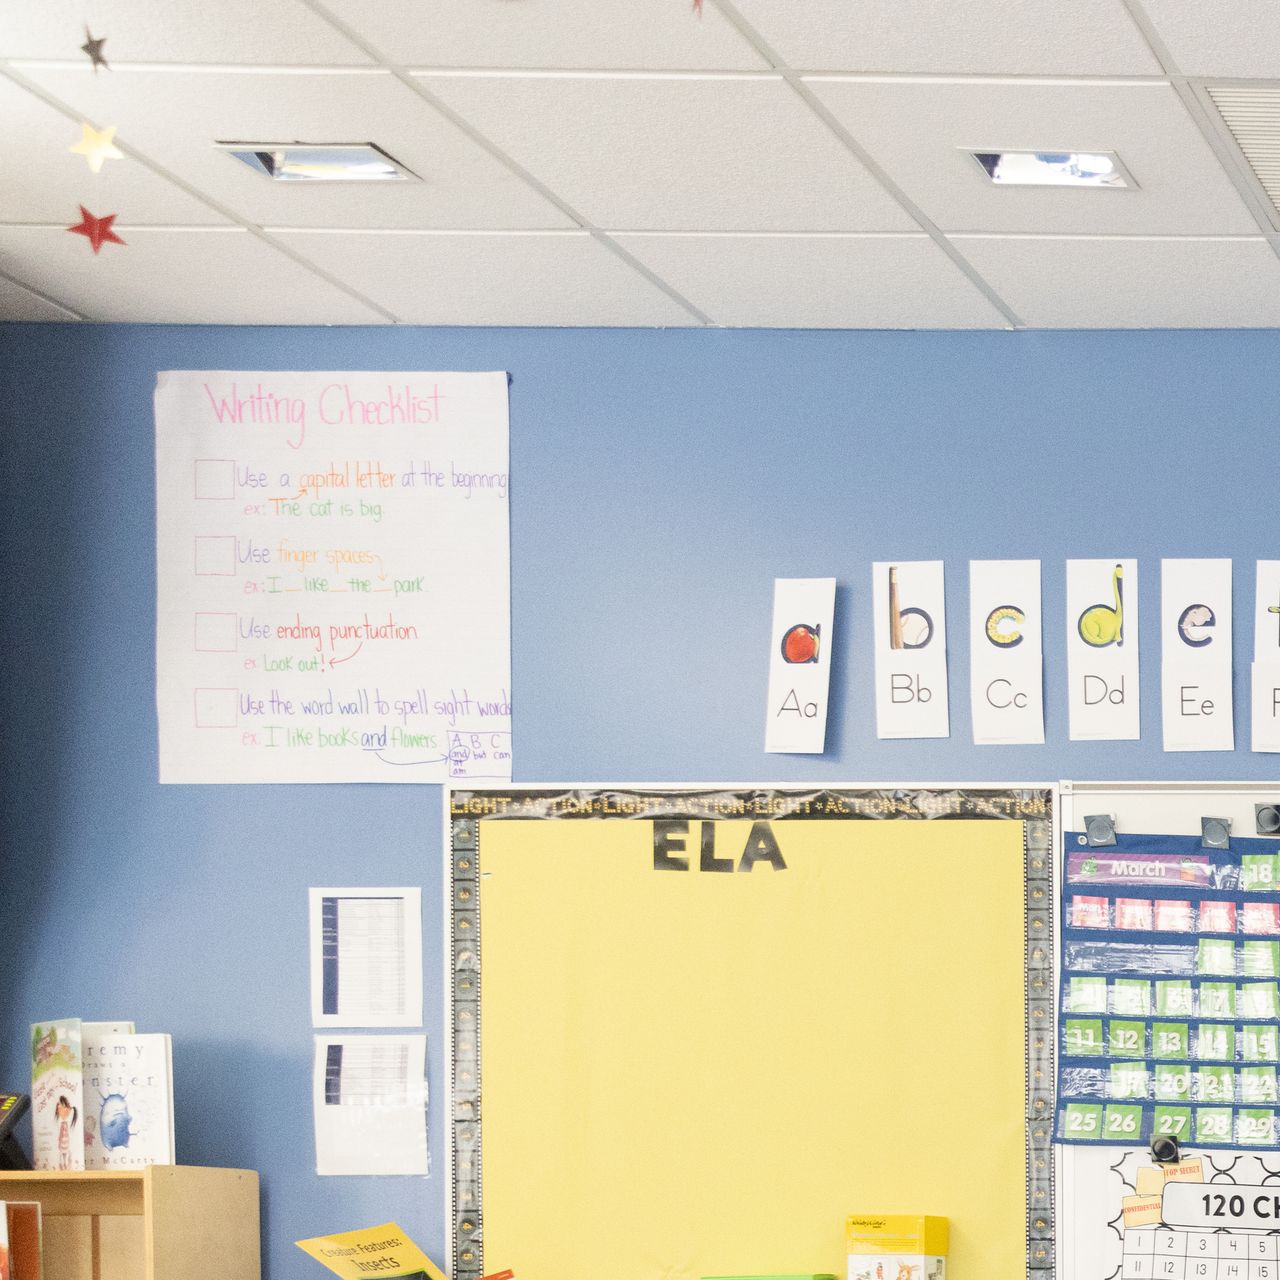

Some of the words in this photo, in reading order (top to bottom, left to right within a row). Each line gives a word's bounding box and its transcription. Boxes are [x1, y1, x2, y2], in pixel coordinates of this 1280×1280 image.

[203, 382, 306, 451] Writing
[318, 383, 446, 425] Checklist
[238, 466, 268, 488] Use
[280, 473, 290, 488] a
[300, 462, 350, 499] capital
[355, 462, 395, 488] letter
[402, 463, 417, 487] at
[421, 463, 445, 488] the
[452, 462, 506, 499] beginning
[244, 503, 266, 515] ex:
[269, 498, 302, 517] The
[309, 500, 332, 517] cat
[340, 504, 353, 517] is
[238, 540, 271, 564] Use
[278, 539, 317, 573] finger
[326, 548, 374, 573] spaces
[244, 579, 266, 594] ex:
[267, 577, 282, 593] I
[304, 577, 329, 593] like
[346, 577, 372, 593] the
[888, 566, 934, 650] b
[1076, 564, 1125, 649] d
[240, 619, 273, 640] Use
[277, 613, 322, 652] ending
[330, 613, 418, 651] punctuation
[985, 605, 1026, 648] c
[1178, 603, 1216, 648] e
[780, 623, 821, 664] a
[264, 655, 292, 671] Look
[298, 654, 326, 673] out!
[777, 689, 817, 718] Aa
[891, 674, 932, 703] Bb
[986, 678, 1027, 709] Cc
[1084, 675, 1124, 705] Dd
[1181, 686, 1214, 716] Ee
[240, 691, 266, 716] Use
[269, 689, 295, 716] the
[301, 688, 333, 715] word
[338, 688, 369, 715] wall
[375, 688, 390, 715] to
[395, 688, 428, 726] spell
[434, 688, 473, 726] sight
[264, 727, 280, 747] I
[287, 727, 313, 747] like
[318, 727, 359, 747] books
[361, 726, 387, 747] and
[452, 798, 512, 814] LIGHT
[653, 820, 788, 874] ELA
[1111, 860, 1166, 877] March
[1250, 865, 1272, 882] 18
[1115, 1031, 1138, 1050] 12
[1070, 1113, 1097, 1131] 25
[1109, 1114, 1136, 1132] 26
[1160, 1115, 1187, 1132] 27
[1202, 1194, 1245, 1218] 120
[359, 1238, 401, 1254] Features:
[352, 1256, 401, 1272] Insects
